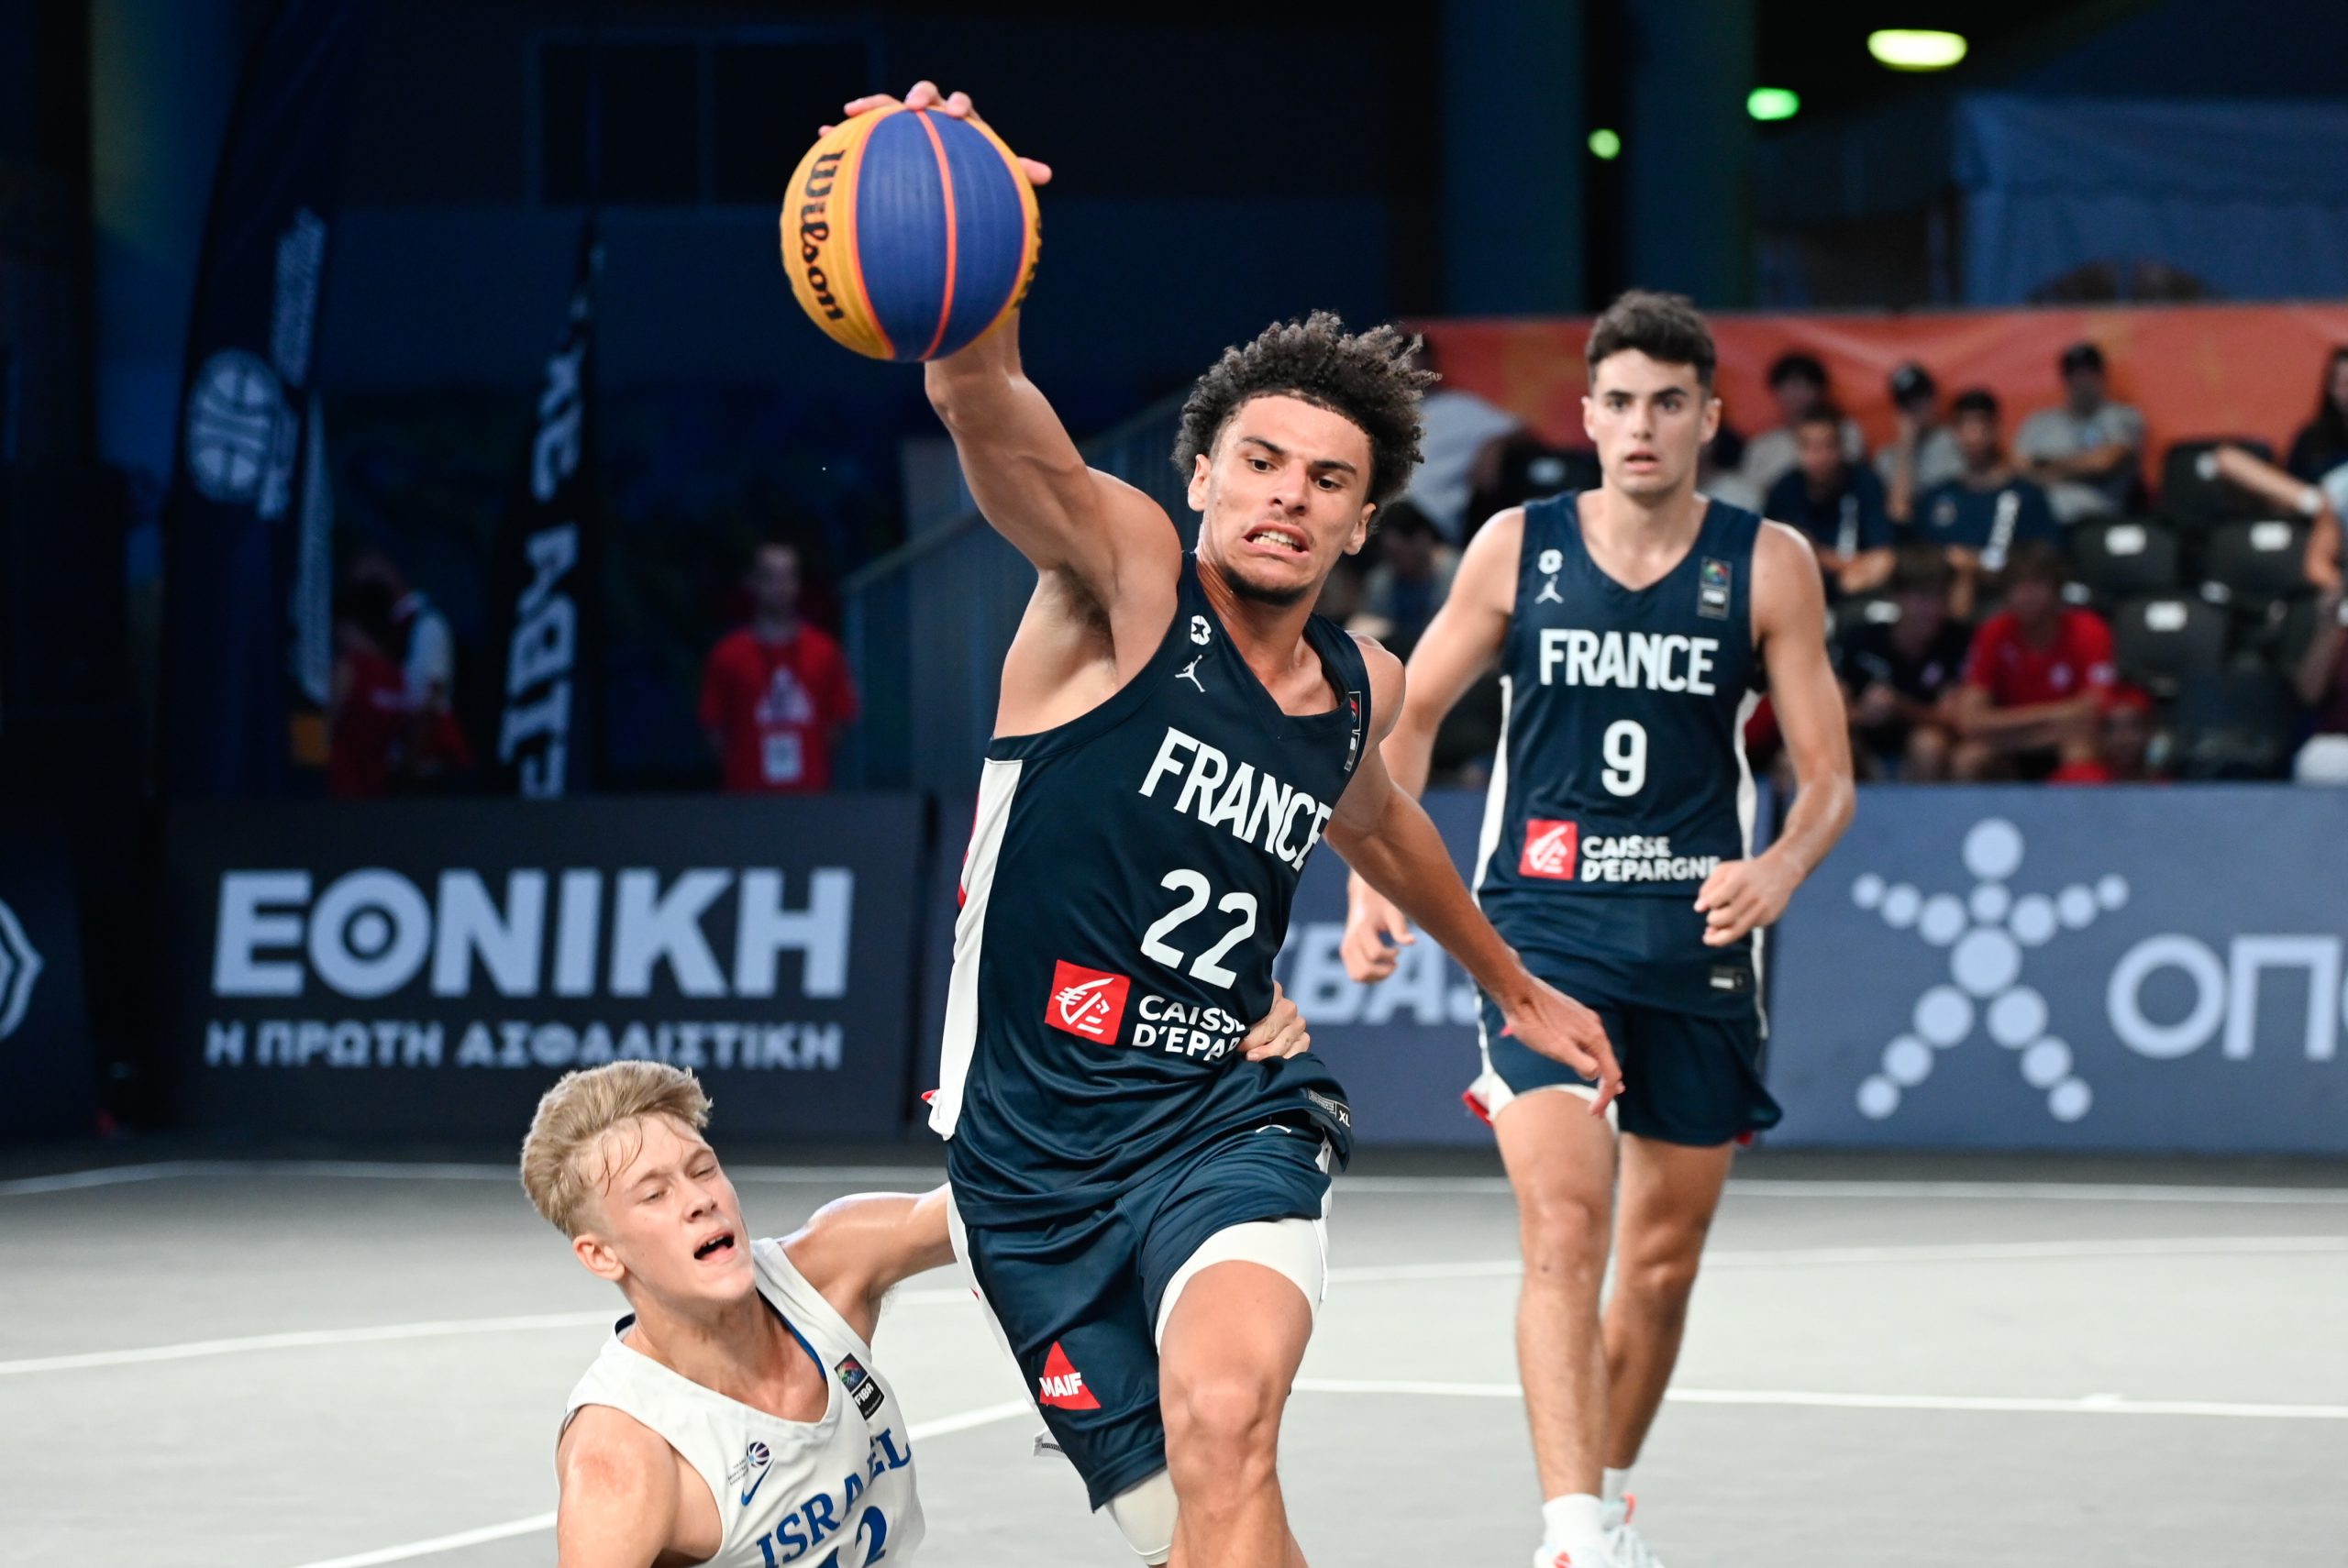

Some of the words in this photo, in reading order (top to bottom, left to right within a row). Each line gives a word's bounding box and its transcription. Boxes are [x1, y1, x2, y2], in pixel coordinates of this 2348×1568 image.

[801, 149, 846, 320] Wilson
[1540, 628, 1719, 696] FRANCE
[1601, 719, 1647, 797] 9
[1581, 834, 1672, 859] CAISSE
[1140, 868, 1257, 989] 22
[2107, 932, 2348, 1061] ΟΠ
[205, 1020, 246, 1067] Η
[256, 1020, 445, 1068] ΠΡΩΤΗ
[1339, 1110, 1351, 1128] XL
[854, 1382, 875, 1406] FIBA
[1039, 1372, 1082, 1397] MAIF
